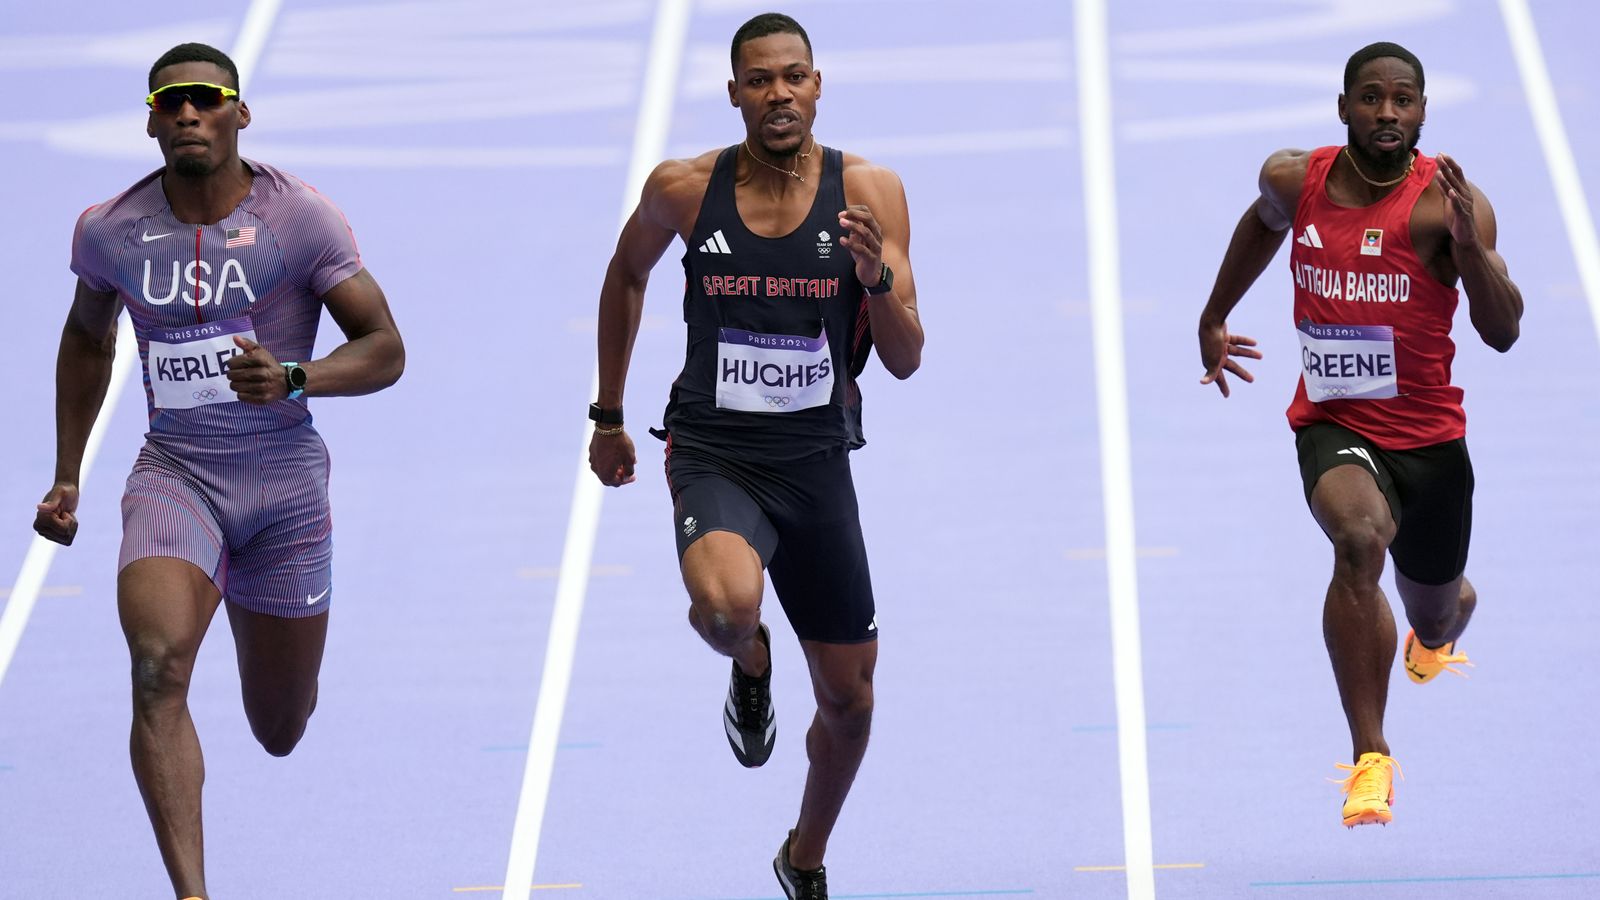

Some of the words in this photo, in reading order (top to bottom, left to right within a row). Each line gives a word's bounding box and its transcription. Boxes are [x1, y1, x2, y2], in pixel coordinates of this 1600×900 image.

[142, 259, 256, 307] USA
[702, 275, 761, 296] GREAT
[765, 276, 840, 299] BRITAIN
[165, 330, 191, 340] PARIS
[194, 325, 221, 337] 2024
[1309, 325, 1332, 336] PARIS
[1335, 328, 1362, 337] 2024
[748, 335, 777, 346] PARIS
[780, 338, 807, 348] 2024
[722, 357, 830, 388] HUGHES
